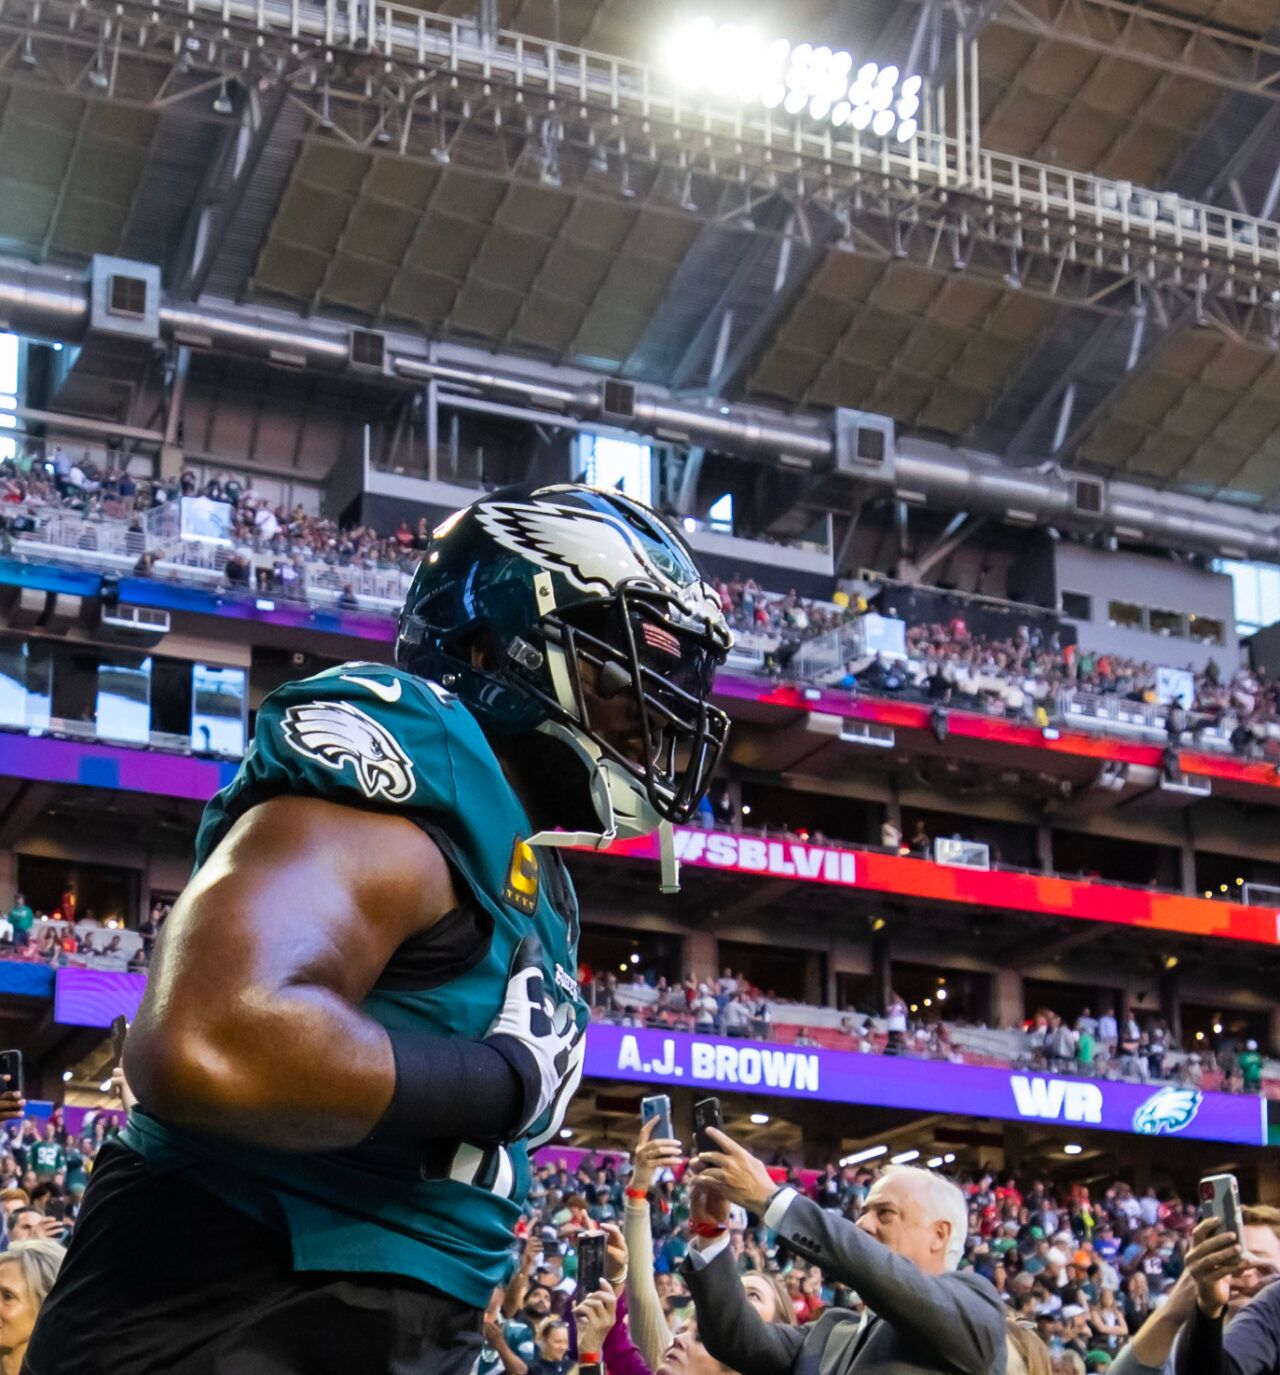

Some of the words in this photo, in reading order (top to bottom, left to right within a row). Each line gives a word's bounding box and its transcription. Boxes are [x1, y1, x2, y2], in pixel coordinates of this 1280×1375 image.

[673, 830, 855, 883] #SBLVII
[618, 1034, 683, 1077] A.J.
[691, 1042, 819, 1091] BROWN
[1011, 1075, 1103, 1124] WR
